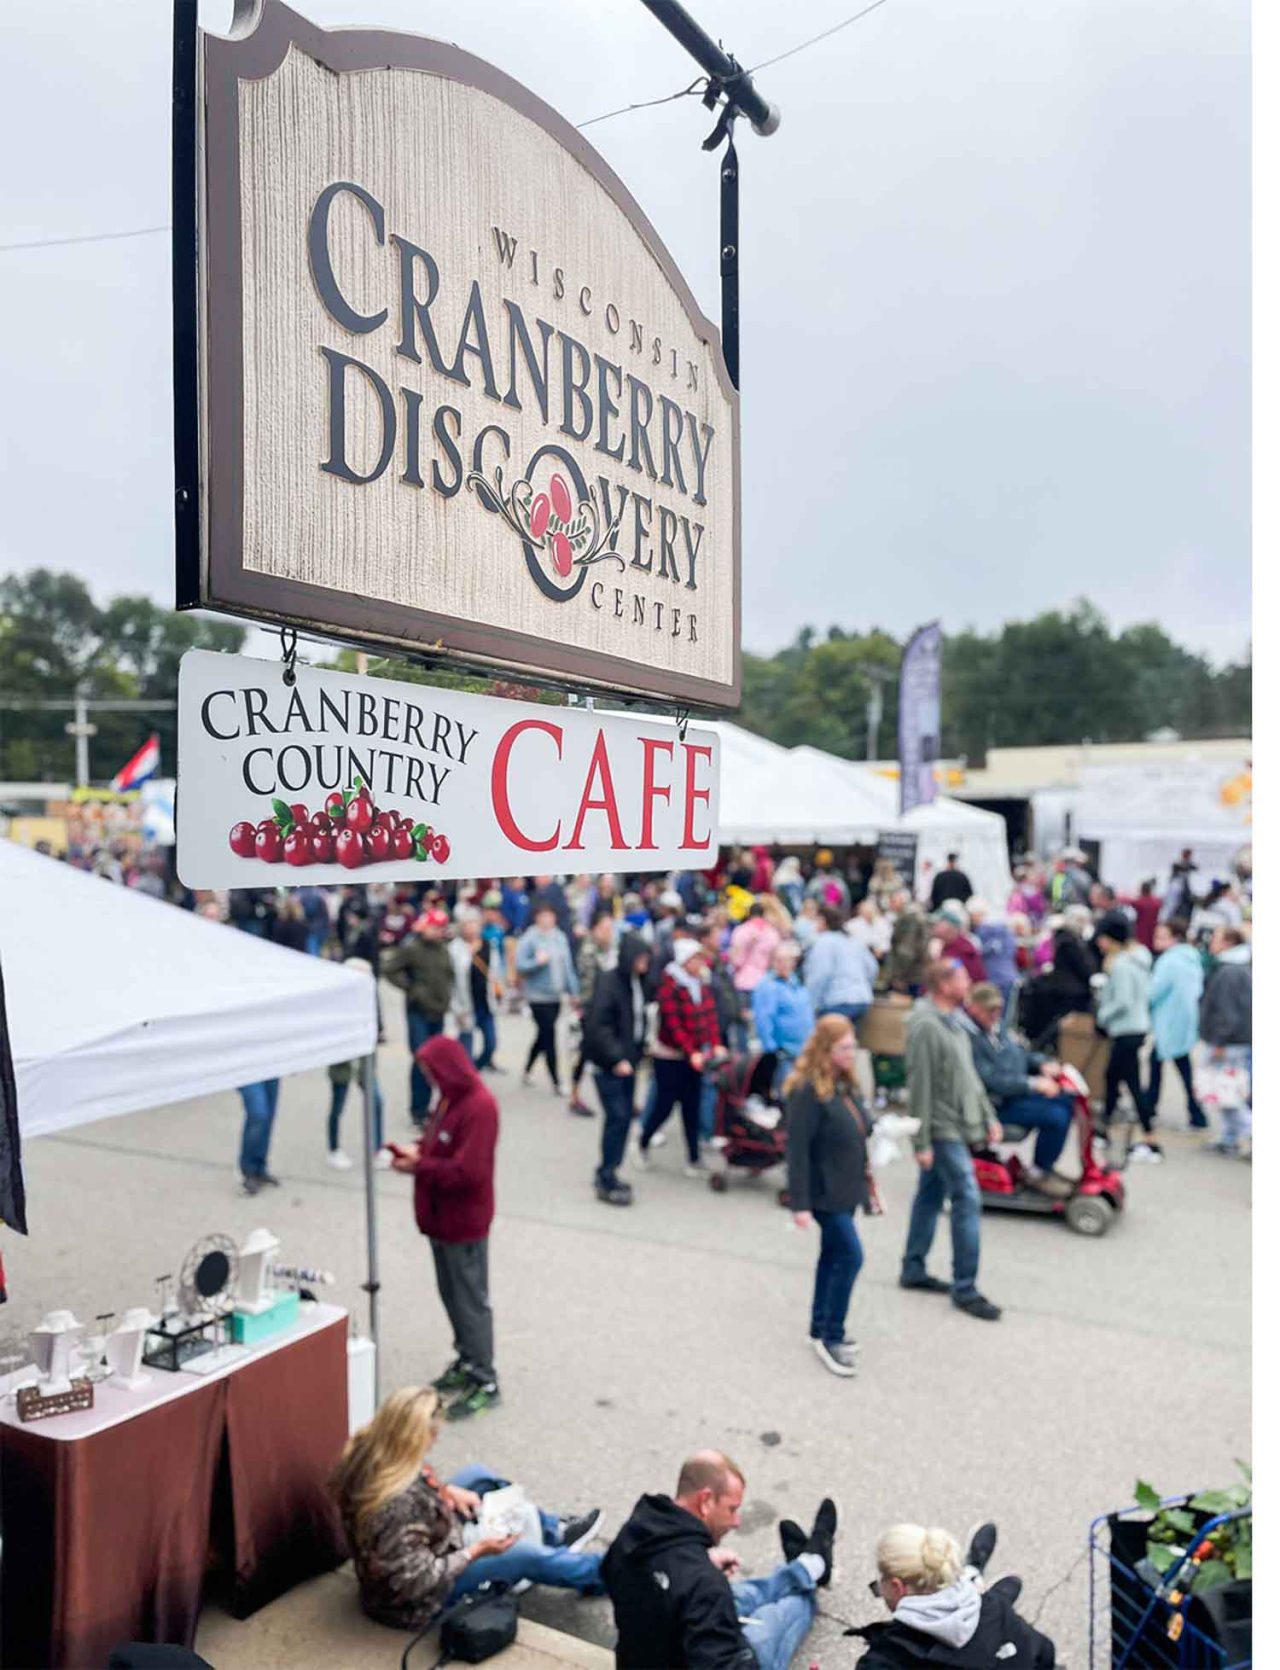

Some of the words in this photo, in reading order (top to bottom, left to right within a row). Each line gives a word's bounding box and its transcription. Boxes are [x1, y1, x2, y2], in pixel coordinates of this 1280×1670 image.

[307, 181, 715, 506] CRANBERRY
[492, 226, 699, 391] WISCONSIN
[319, 345, 706, 601] DISCOVERY
[591, 581, 698, 642] CENTER
[200, 686, 480, 766] CRANBERRY
[242, 744, 452, 806] COUNTRY
[491, 719, 712, 853] CAFE
